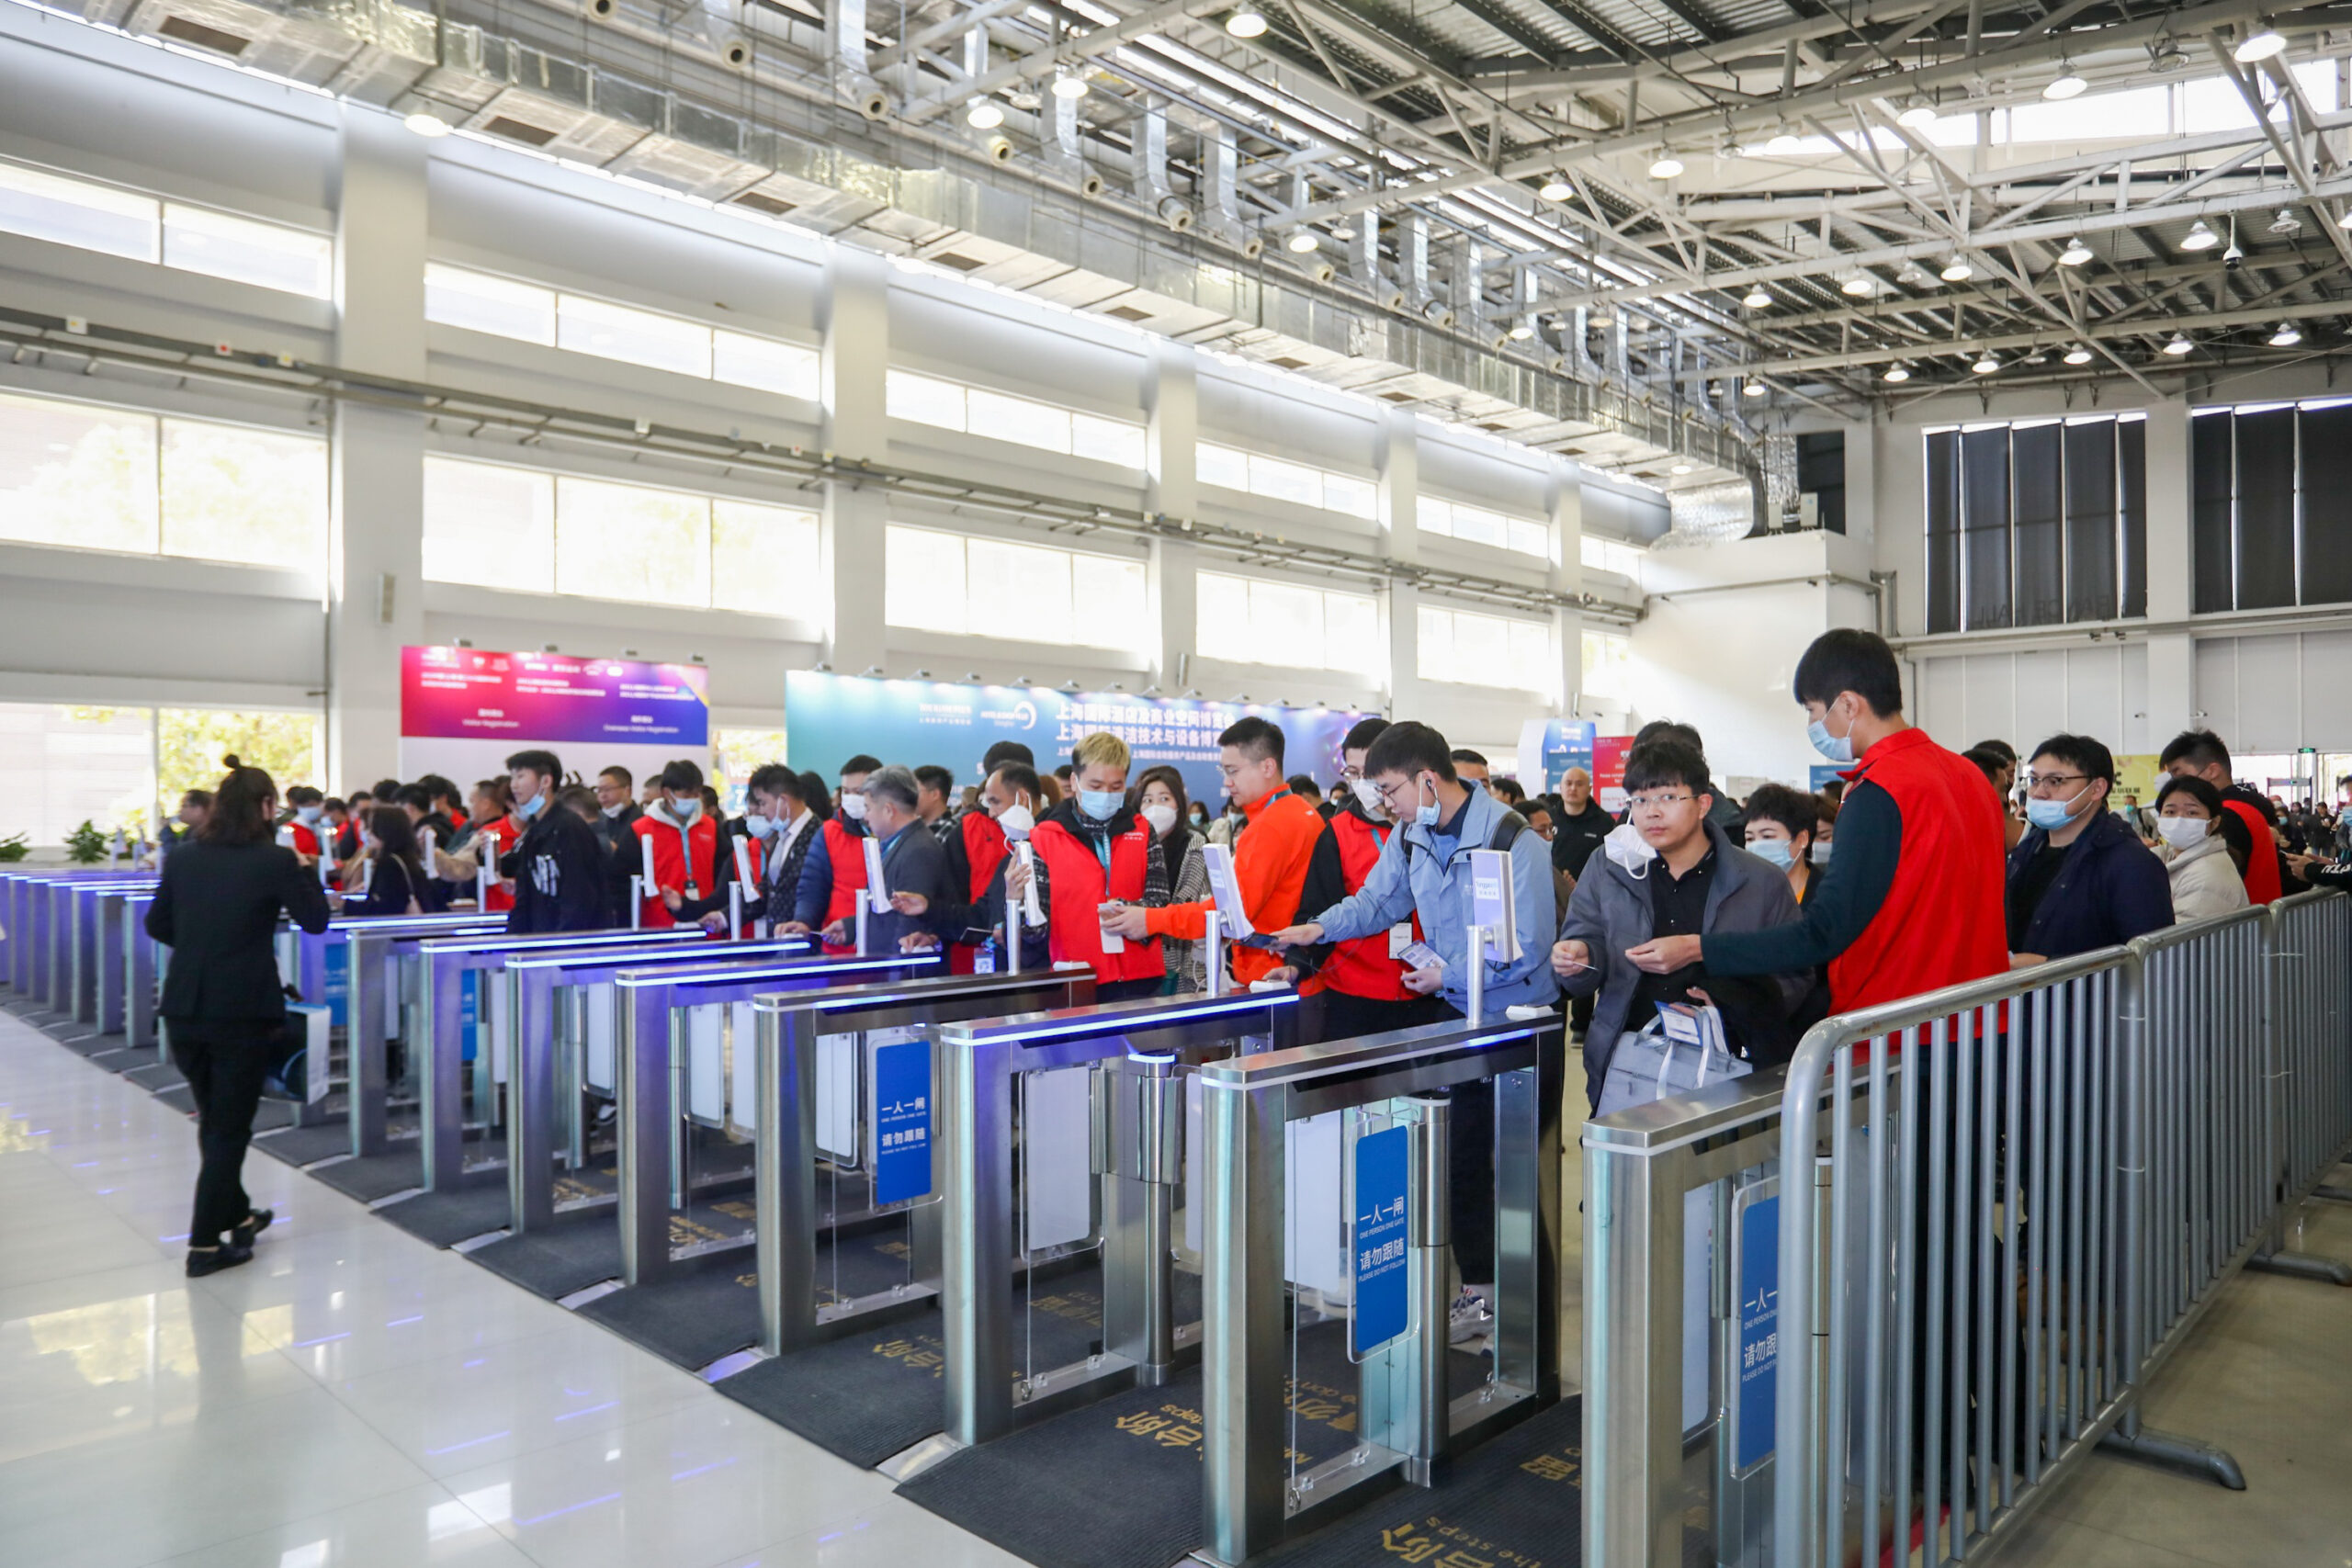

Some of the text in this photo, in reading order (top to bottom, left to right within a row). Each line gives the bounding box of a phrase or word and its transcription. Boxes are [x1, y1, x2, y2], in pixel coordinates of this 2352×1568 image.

[882, 1097, 925, 1114] 一人一闸
[1360, 1196, 1404, 1225] 一人一闸
[1360, 1230, 1369, 1239] ONE
[1360, 1236, 1404, 1271] 请勿跟随
[1426, 1516, 1496, 1552] steps
